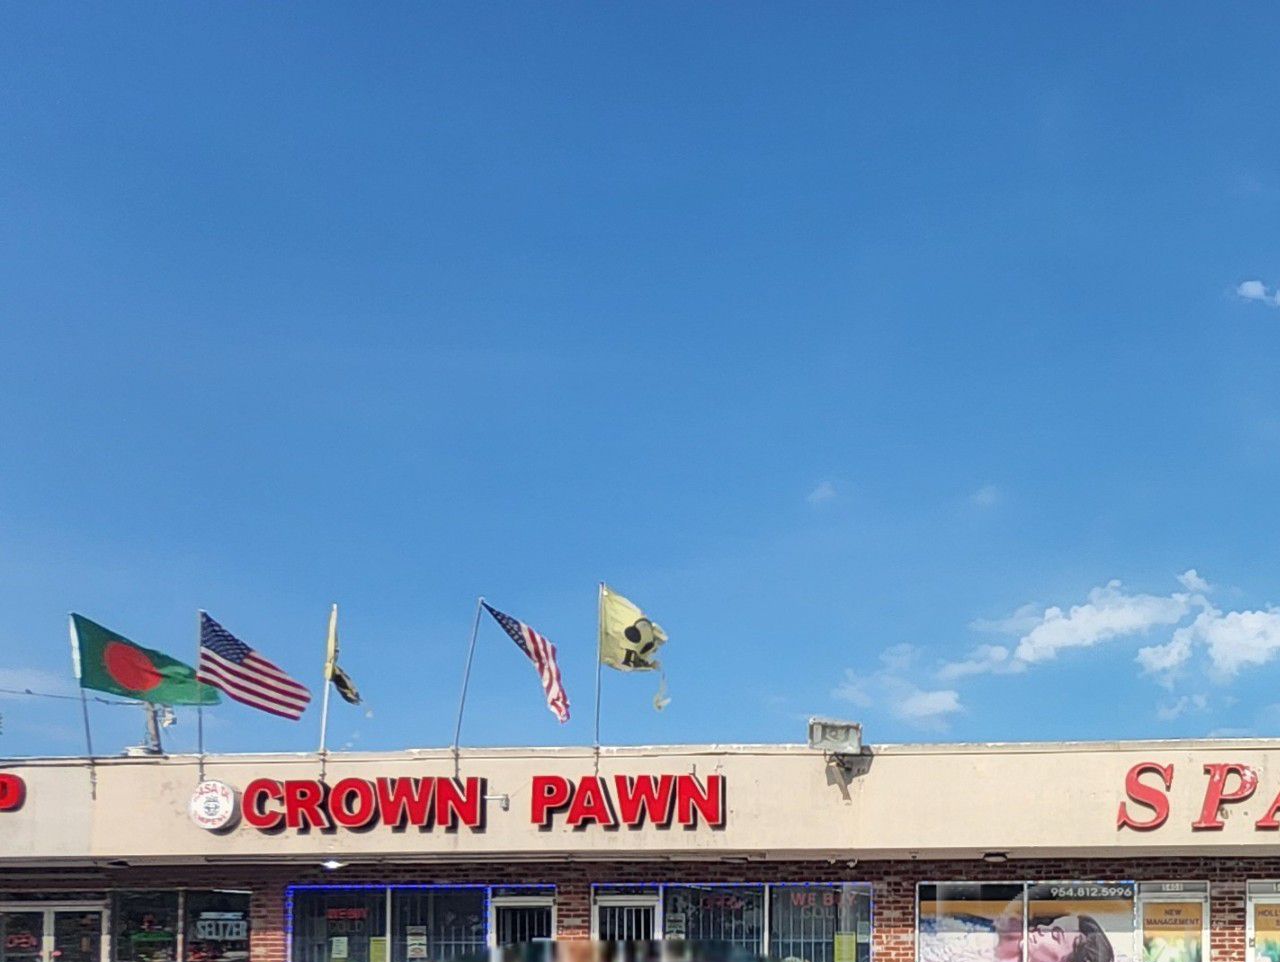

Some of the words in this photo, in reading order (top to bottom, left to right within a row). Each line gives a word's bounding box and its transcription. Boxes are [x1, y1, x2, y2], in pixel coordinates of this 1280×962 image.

[242, 776, 483, 830] CROWN
[531, 775, 724, 827] PAWN
[1050, 887, 1133, 898] 954.812.5996
[1164, 909, 1182, 917] NEW
[1145, 918, 1200, 927] MANAGEMENT
